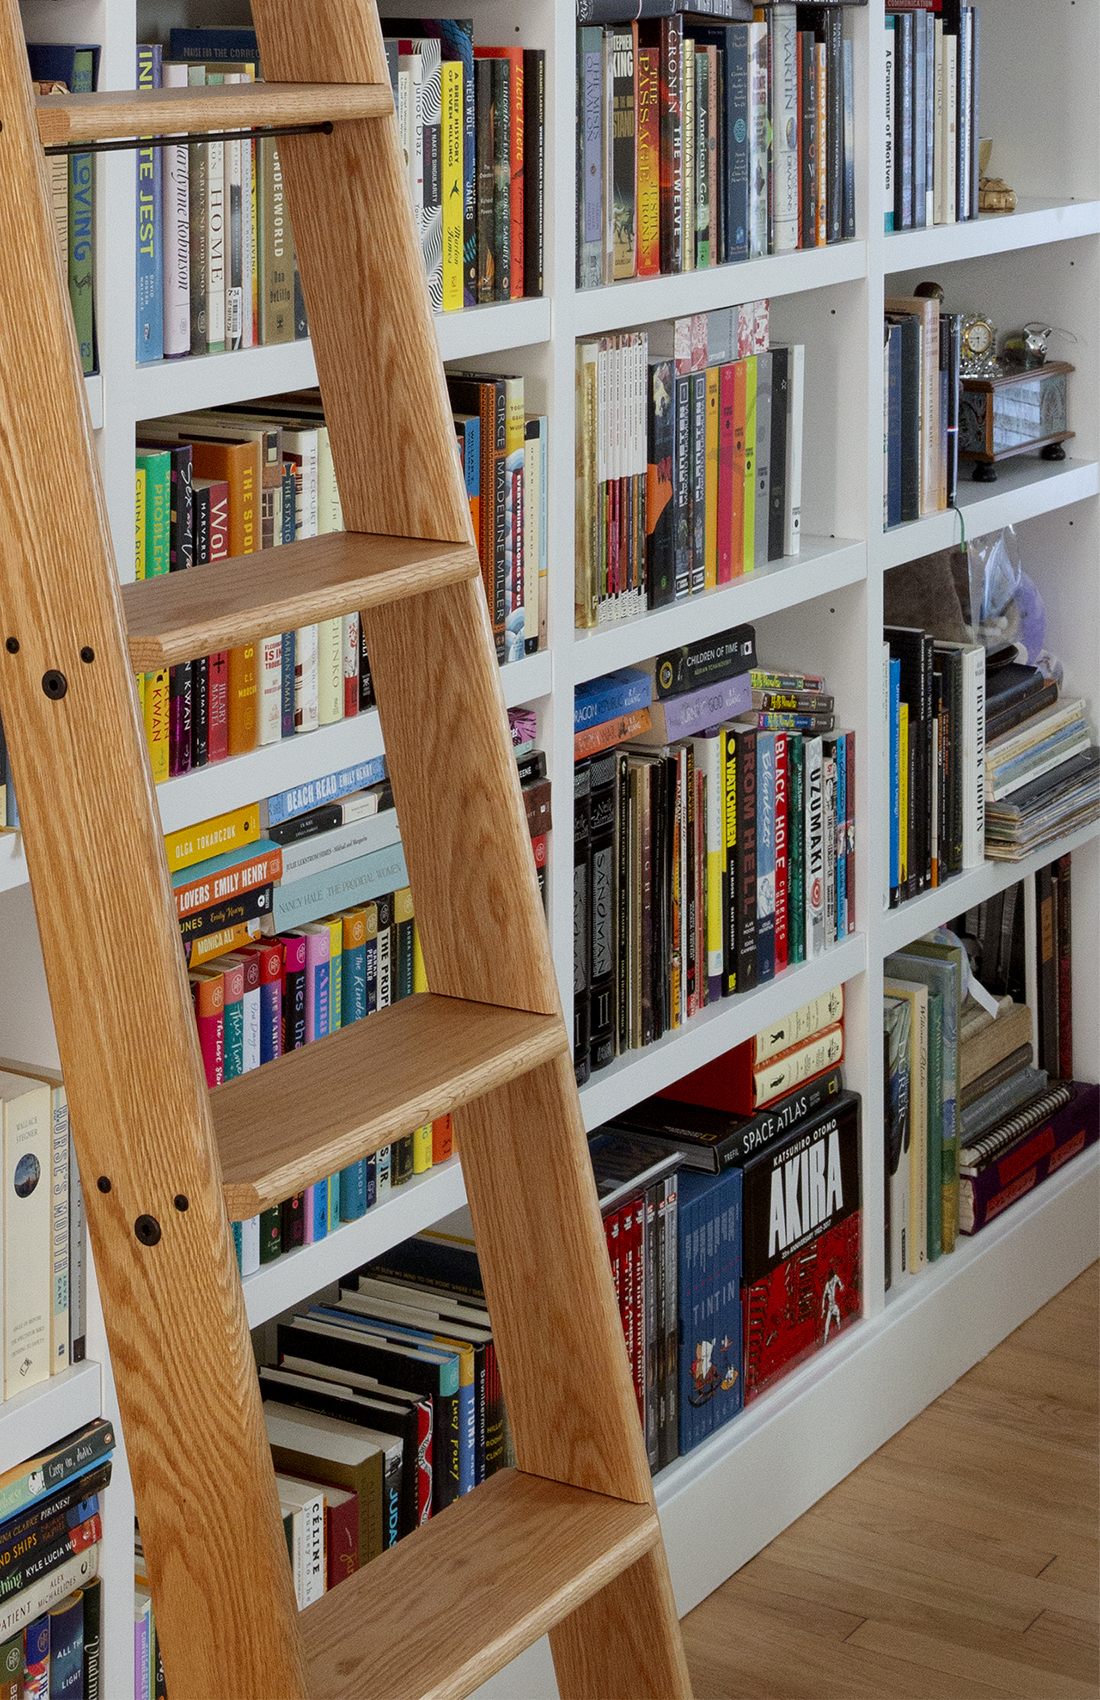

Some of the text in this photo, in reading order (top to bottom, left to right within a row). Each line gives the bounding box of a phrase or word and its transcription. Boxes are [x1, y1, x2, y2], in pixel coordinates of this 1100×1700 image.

[639, 56, 650, 184] PASSAGE
[140, 188, 154, 258] JEST
[177, 207, 190, 291] Robinson
[211, 189, 223, 285] HOME
[496, 394, 506, 621] CIRCE MADELINE MILLER
[686, 641, 738, 668] CHILDREN OF TIME
[287, 760, 384, 812] BEACH READ EMILY HENRY
[976, 686, 984, 833] FRYDERYK CHOPIN
[726, 757, 736, 848] WATCHMEN
[743, 733, 755, 915] FROM HELL
[775, 740, 785, 871] BLACK HOLE
[810, 767, 822, 875] UZUMAKI
[176, 825, 236, 857] OLGA TOKARCZUK
[181, 861, 268, 914] LOVERS EMILY HENRY
[197, 930, 234, 955] MONICA ALI
[724, 1096, 807, 1163] TREFIL SPACE ATLAS
[772, 1119, 836, 1167] KATSUHIRO OTOMO
[768, 1128, 844, 1257] AKIRA
[12, 1534, 37, 1562] SHIPS
[26, 1539, 77, 1578] KYLE LUCIA WU
[311, 1502, 321, 1575] CÉLINE
